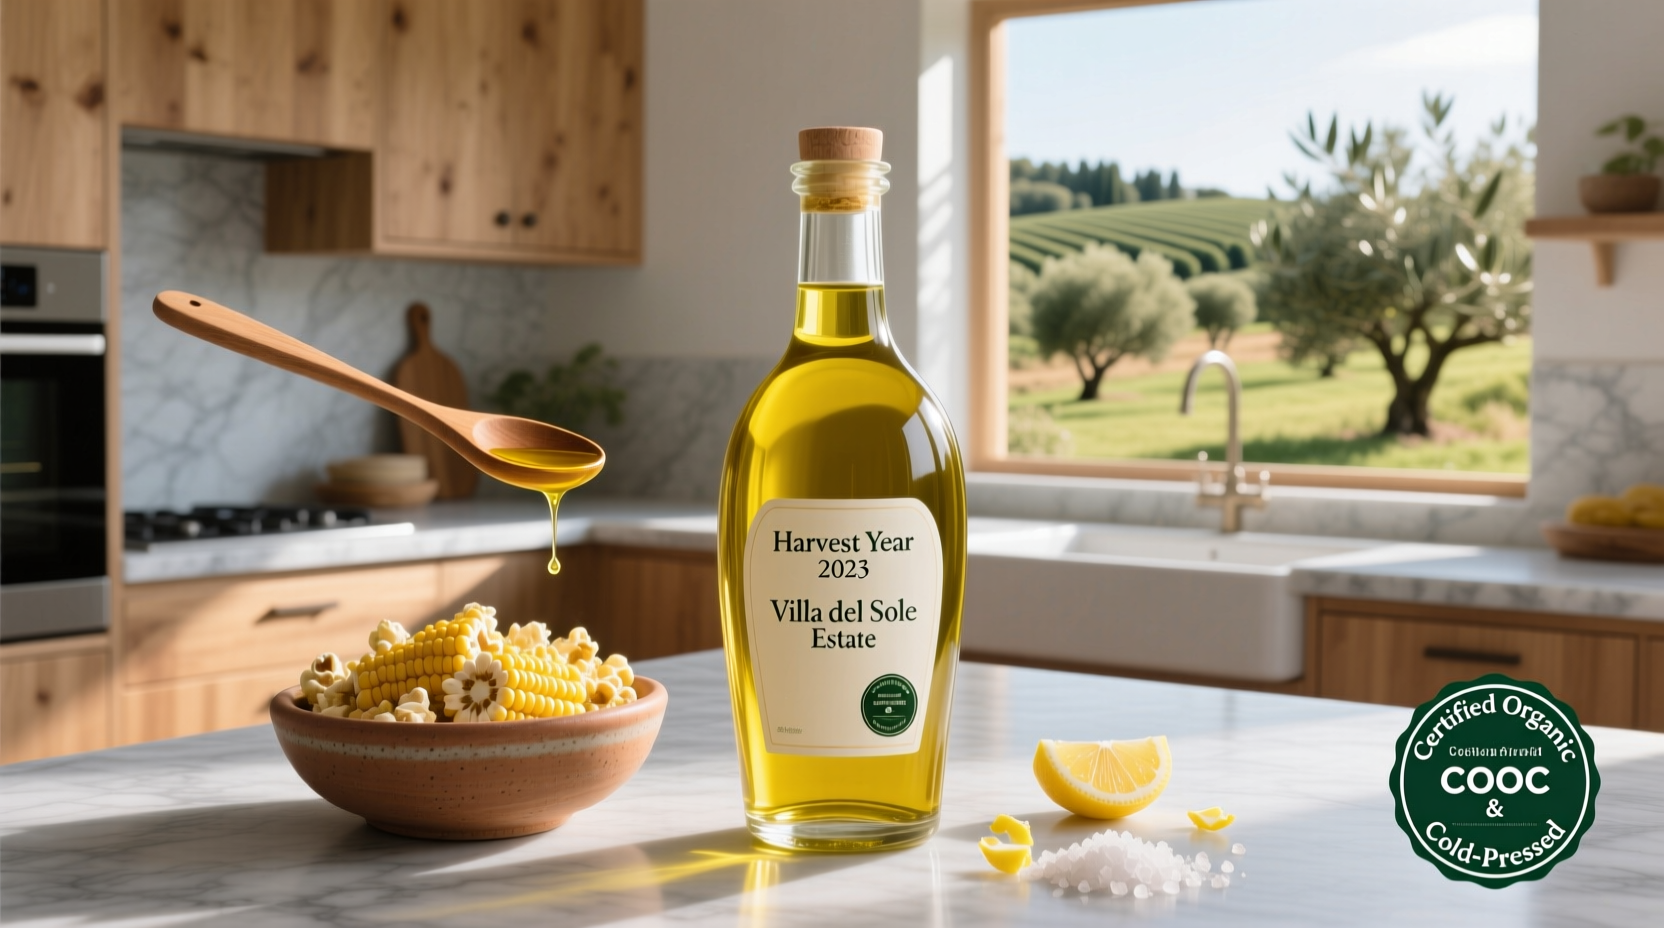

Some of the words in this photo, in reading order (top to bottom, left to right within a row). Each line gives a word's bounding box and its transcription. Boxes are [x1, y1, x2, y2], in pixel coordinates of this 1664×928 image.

[773, 530, 861, 553] Harvest
[865, 530, 914, 552] Year
[818, 559, 870, 579] 2023
[770, 599, 823, 623] Villa
[828, 600, 863, 623] del
[870, 598, 917, 623] Sole
[811, 627, 877, 649] Estate
